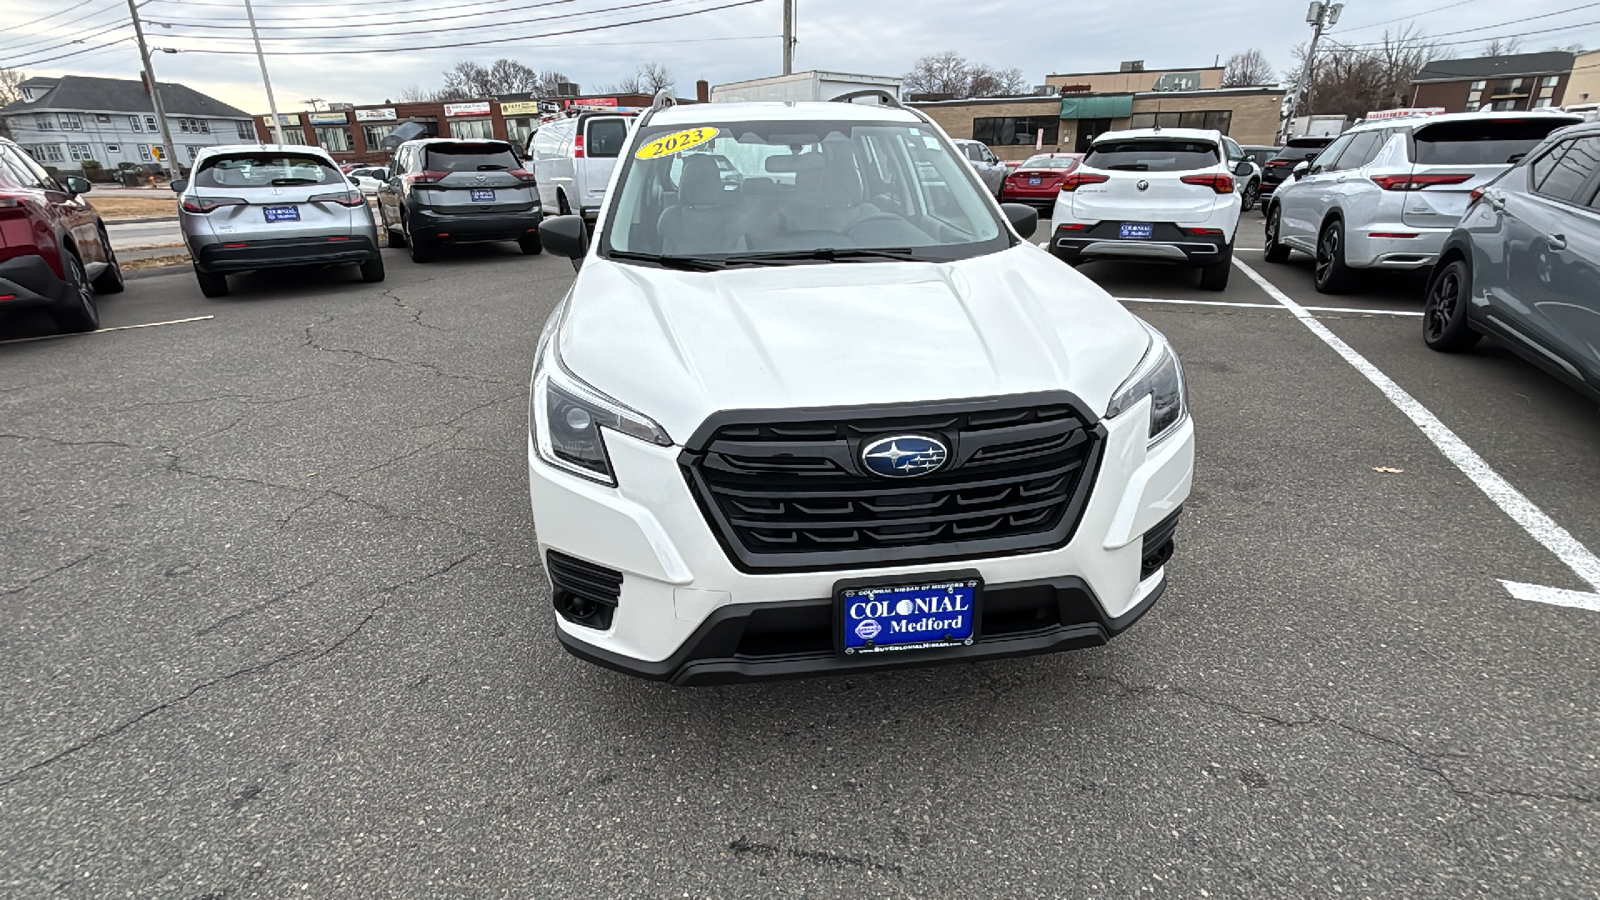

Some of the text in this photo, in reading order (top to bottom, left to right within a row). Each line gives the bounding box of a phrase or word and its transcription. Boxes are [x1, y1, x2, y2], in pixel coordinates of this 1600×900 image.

[652, 129, 704, 156] 2023
[931, 582, 964, 590] MEDFORD
[850, 594, 969, 620] COLONIAL
[889, 615, 963, 634] Medford
